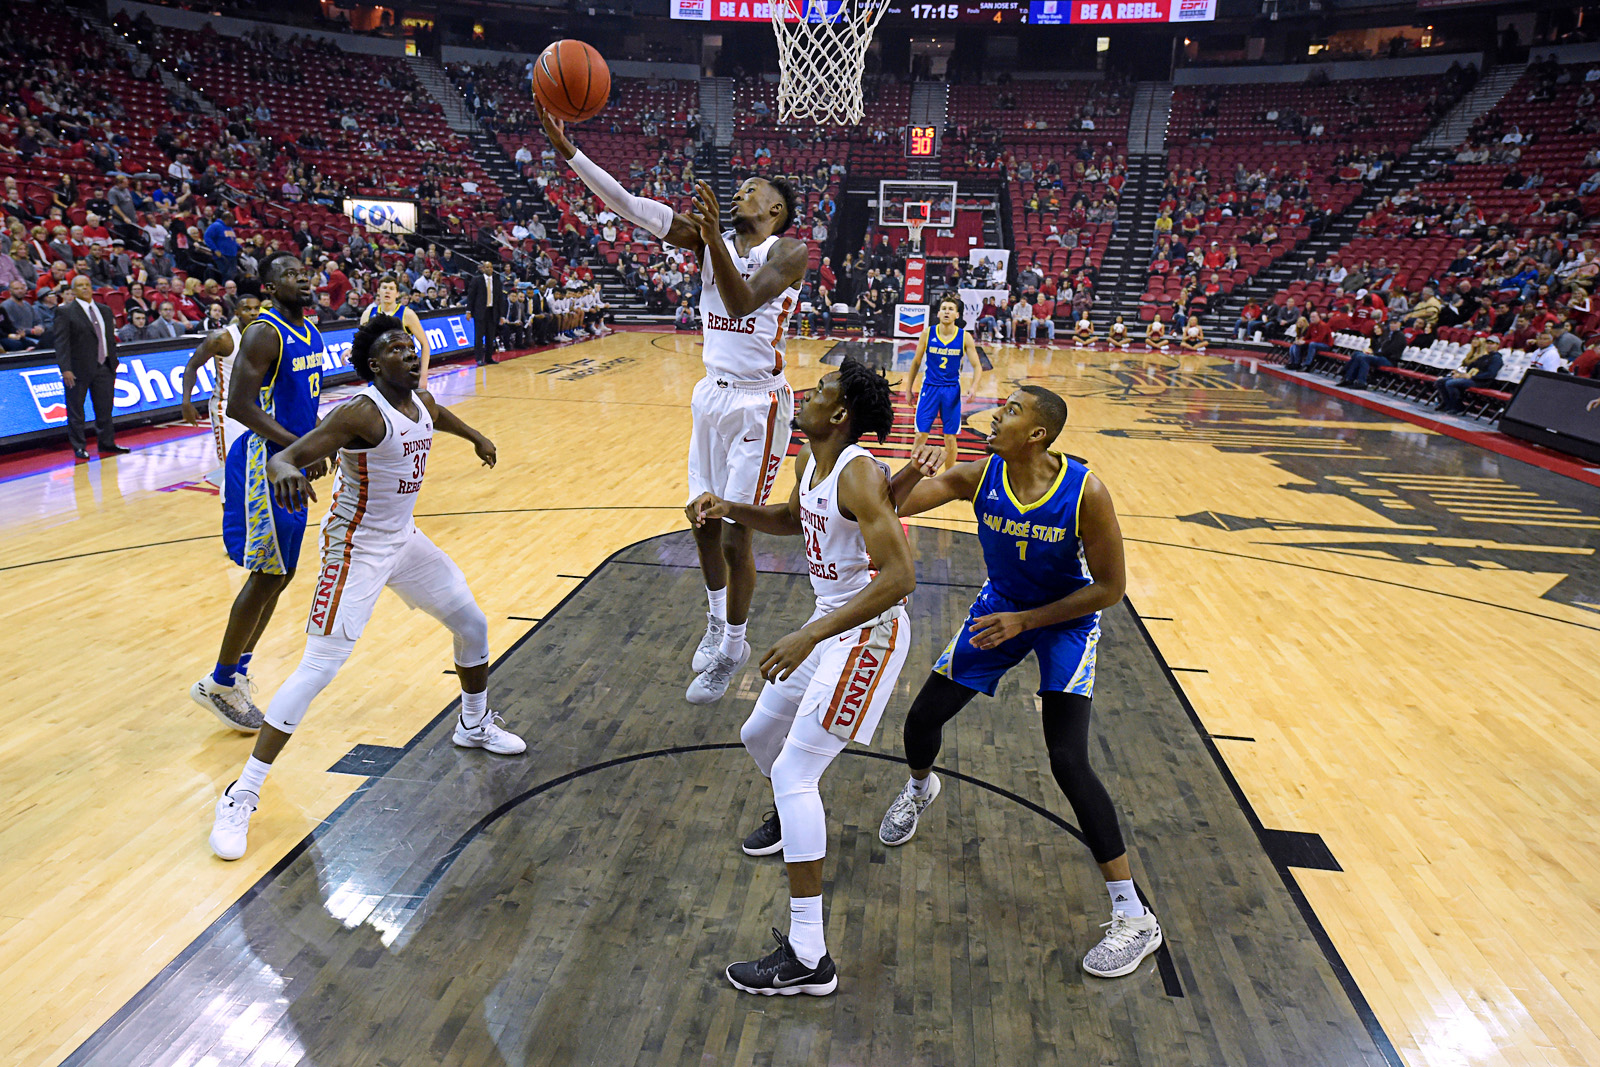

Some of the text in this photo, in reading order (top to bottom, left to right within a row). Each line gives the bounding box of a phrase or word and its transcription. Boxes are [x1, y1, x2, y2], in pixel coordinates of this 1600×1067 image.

[720, 2, 736, 18] BE
[738, 3, 750, 18] A
[911, 4, 959, 19] 17:15
[993, 11, 1002, 23] 4
[1020, 15, 1027, 23] 4
[1080, 3, 1099, 20] BE
[1101, 3, 1113, 19] A
[1116, 2, 1163, 19] REBEL.
[911, 127, 935, 138] 17:15
[911, 136, 932, 155] 30
[353, 204, 404, 227] COX
[707, 311, 756, 335] REBELS
[939, 356, 948, 369] 2
[308, 371, 320, 399] 13
[413, 452, 426, 479] 30
[983, 512, 1003, 532] SAN
[1031, 524, 1066, 543] STATE
[804, 525, 822, 561] 24
[1016, 541, 1029, 561] 1
[312, 564, 340, 629] UNLV
[835, 649, 880, 727] UNLV
